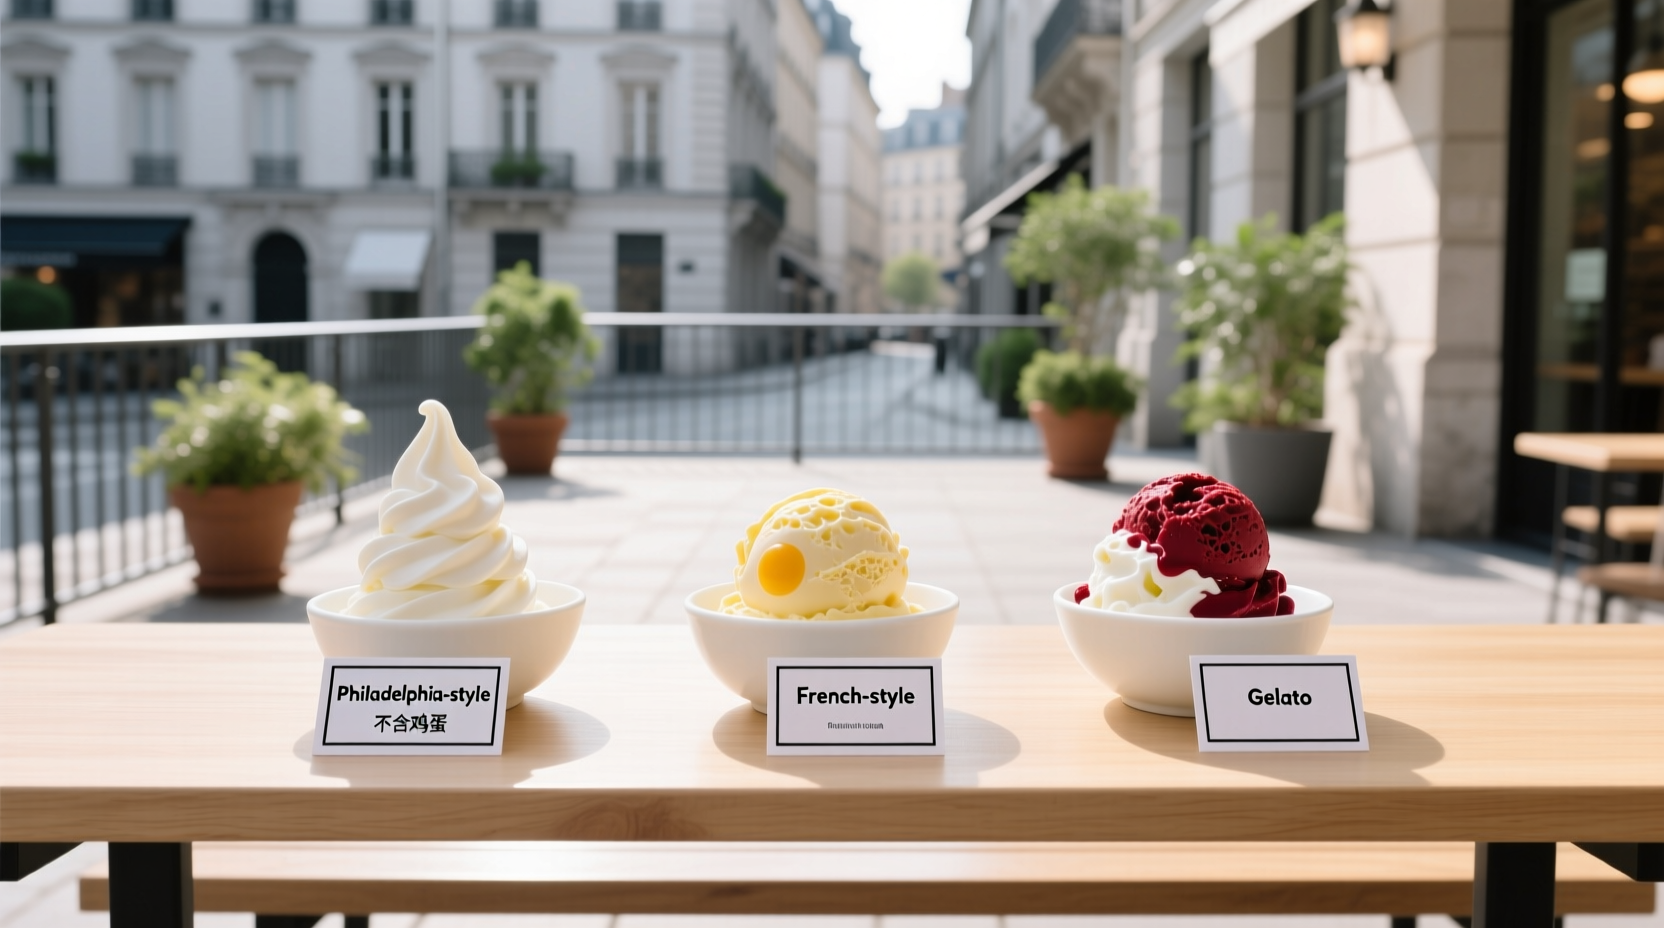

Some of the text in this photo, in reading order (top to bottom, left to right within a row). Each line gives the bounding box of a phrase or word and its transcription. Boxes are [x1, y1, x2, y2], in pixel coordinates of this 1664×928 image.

[337, 684, 491, 707] Philadelphia-style
[797, 686, 915, 709] French-style
[1248, 687, 1313, 706] Gelato
[373, 712, 448, 734] 不含鸡蛋
